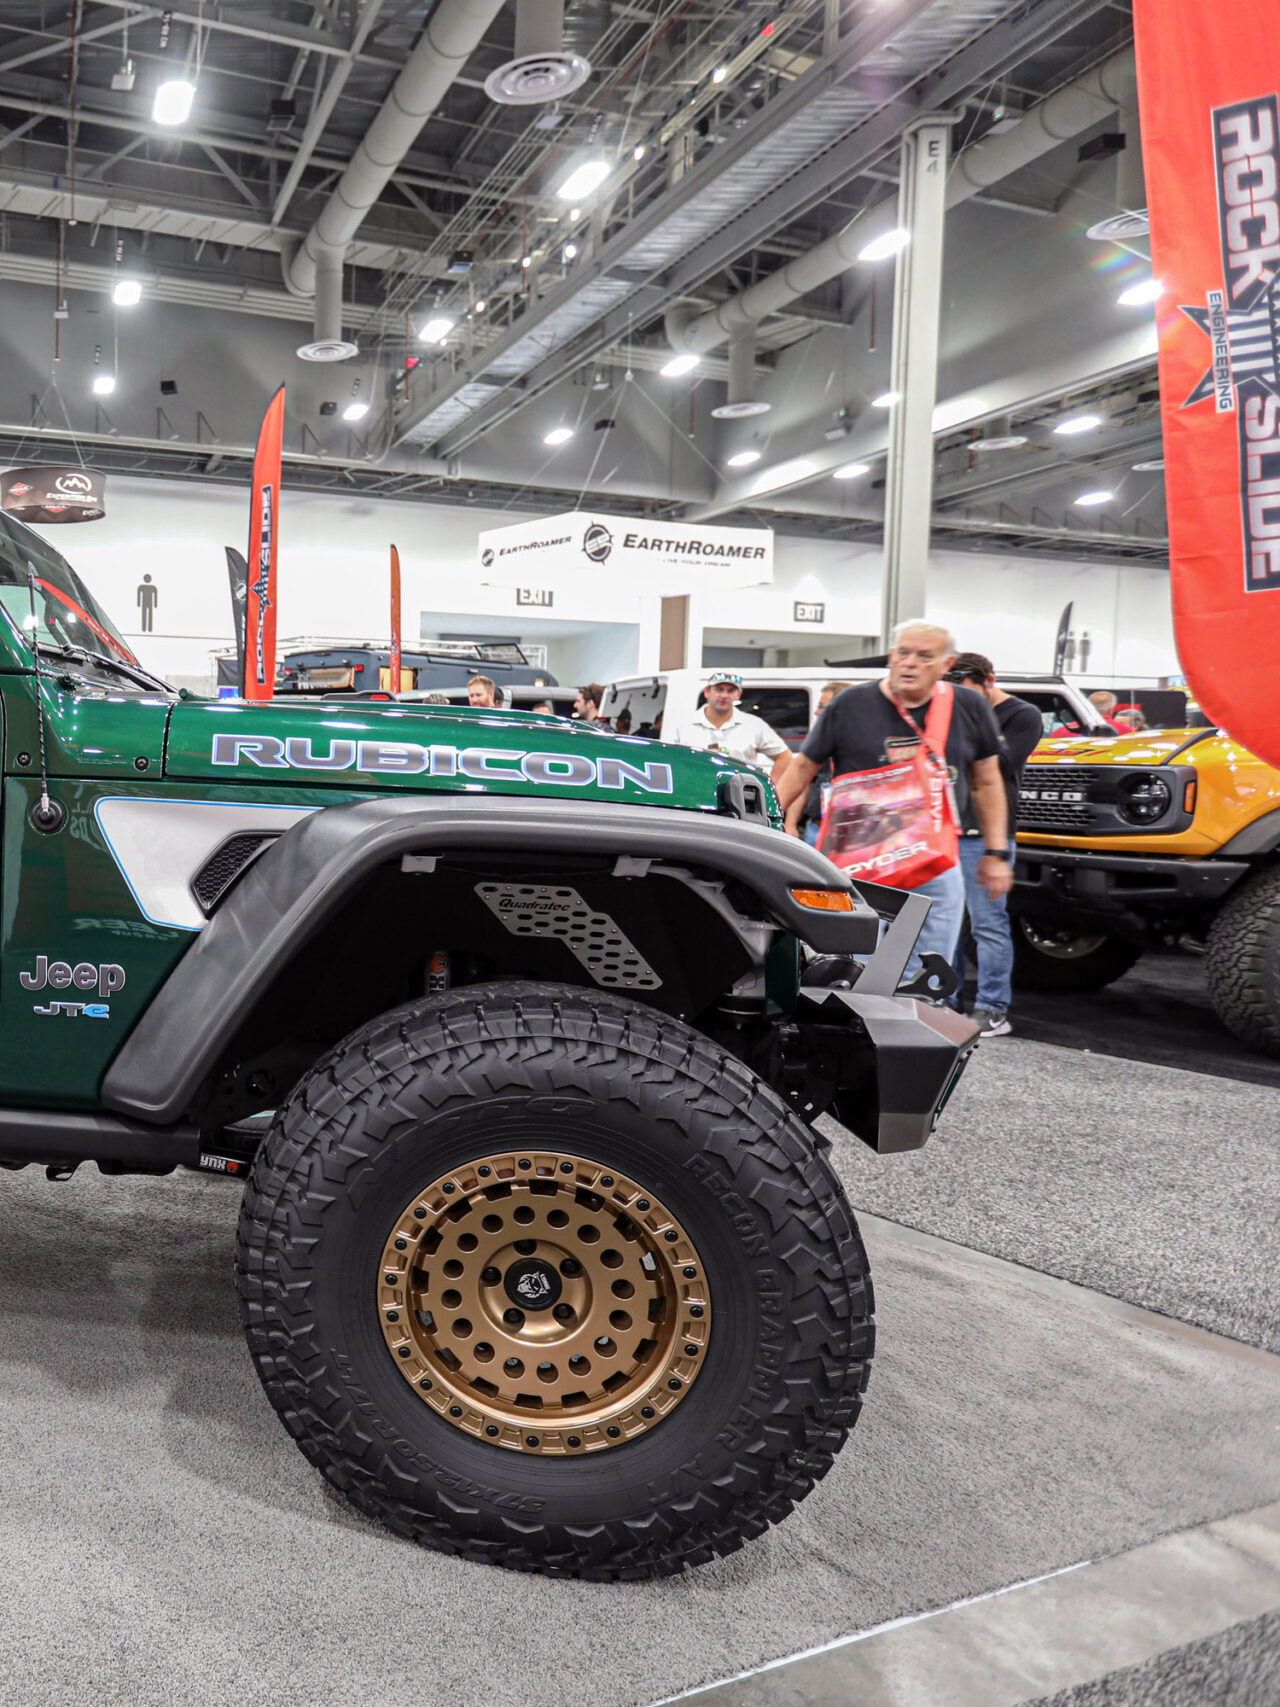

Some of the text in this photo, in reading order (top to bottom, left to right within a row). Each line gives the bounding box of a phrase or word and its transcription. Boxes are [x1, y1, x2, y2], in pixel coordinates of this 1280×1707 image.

[928, 140, 939, 157] E
[1221, 106, 1280, 301] ROCK
[1209, 291, 1234, 410] ENGINEERING
[622, 532, 766, 561] EARTHROAMER
[521, 588, 550, 605] EXIT
[797, 604, 825, 621] EXIT
[212, 732, 674, 794] RUBICON
[1019, 790, 1083, 801] NCO
[841, 841, 928, 880] PYDER
[498, 898, 571, 912] Quadratec
[19, 955, 126, 998] Jeep
[200, 1155, 226, 1170] YNX
